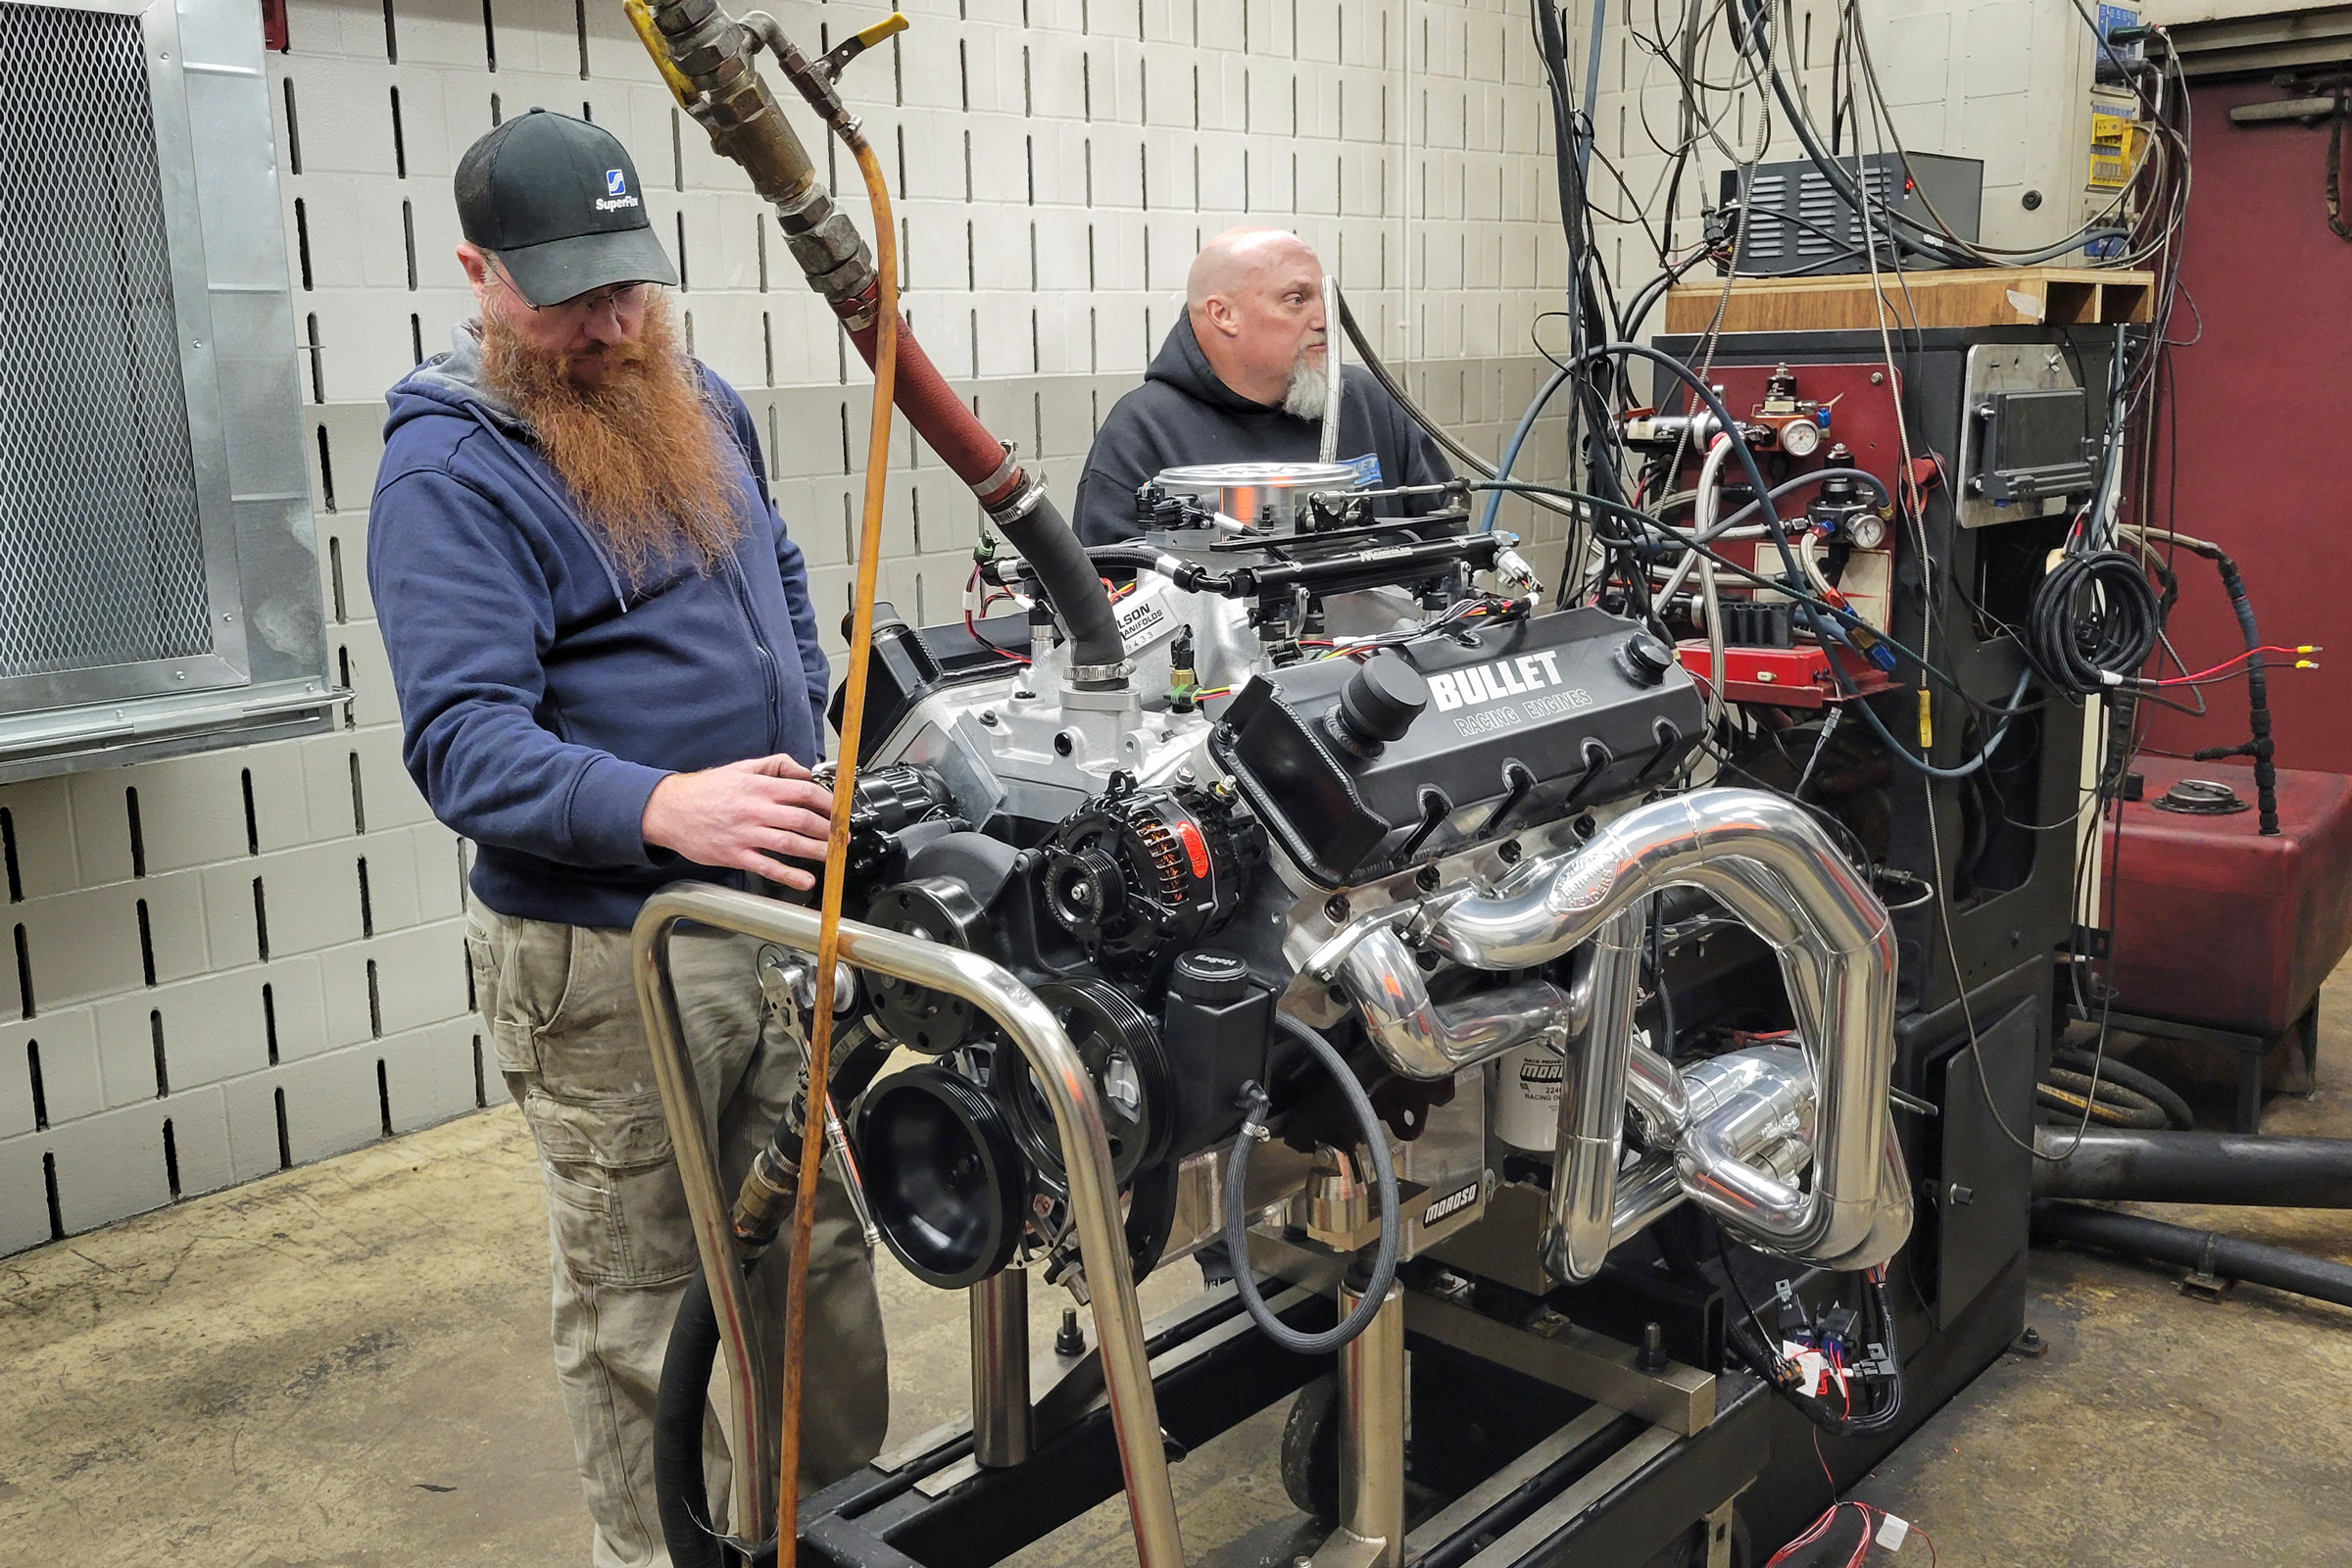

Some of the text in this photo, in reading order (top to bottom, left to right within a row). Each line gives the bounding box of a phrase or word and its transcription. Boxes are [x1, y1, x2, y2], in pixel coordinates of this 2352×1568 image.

[1117, 603, 1151, 629] LSON
[1426, 650, 1563, 712] BULLET
[1452, 688, 1592, 737] RACING ENGINES
[1045, 864, 1074, 932] POWERMASTER
[1072, 858, 1104, 925] POWERMASTER
[1424, 1182, 1478, 1225] MOROSO
